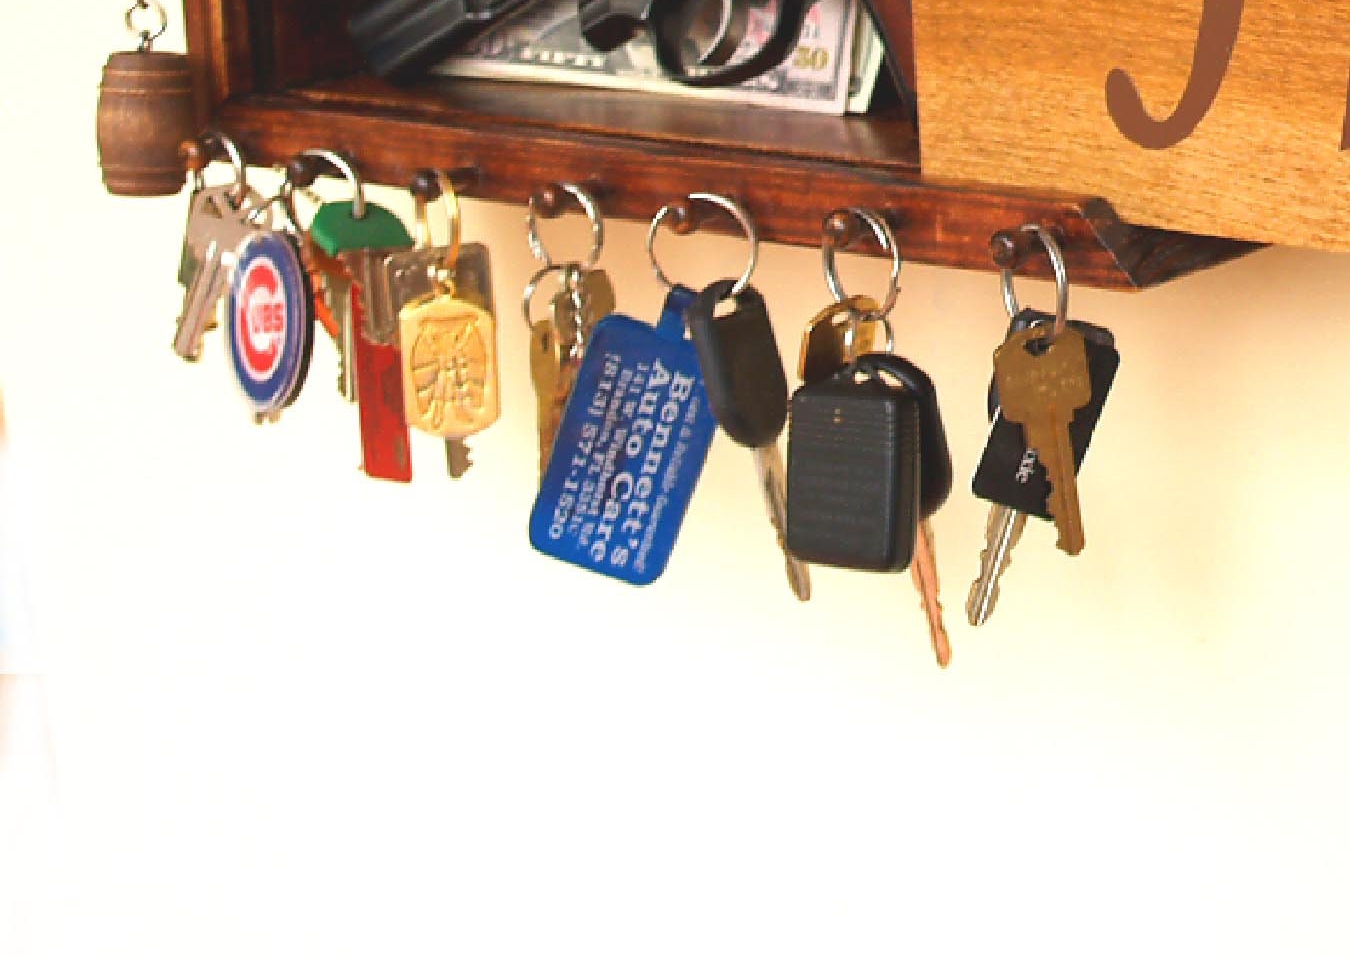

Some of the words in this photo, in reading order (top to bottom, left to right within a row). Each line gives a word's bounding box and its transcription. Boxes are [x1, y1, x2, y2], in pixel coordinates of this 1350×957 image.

[625, 358, 673, 459] Auto
[590, 472, 635, 563] Care
[609, 371, 696, 568] Bennett's
